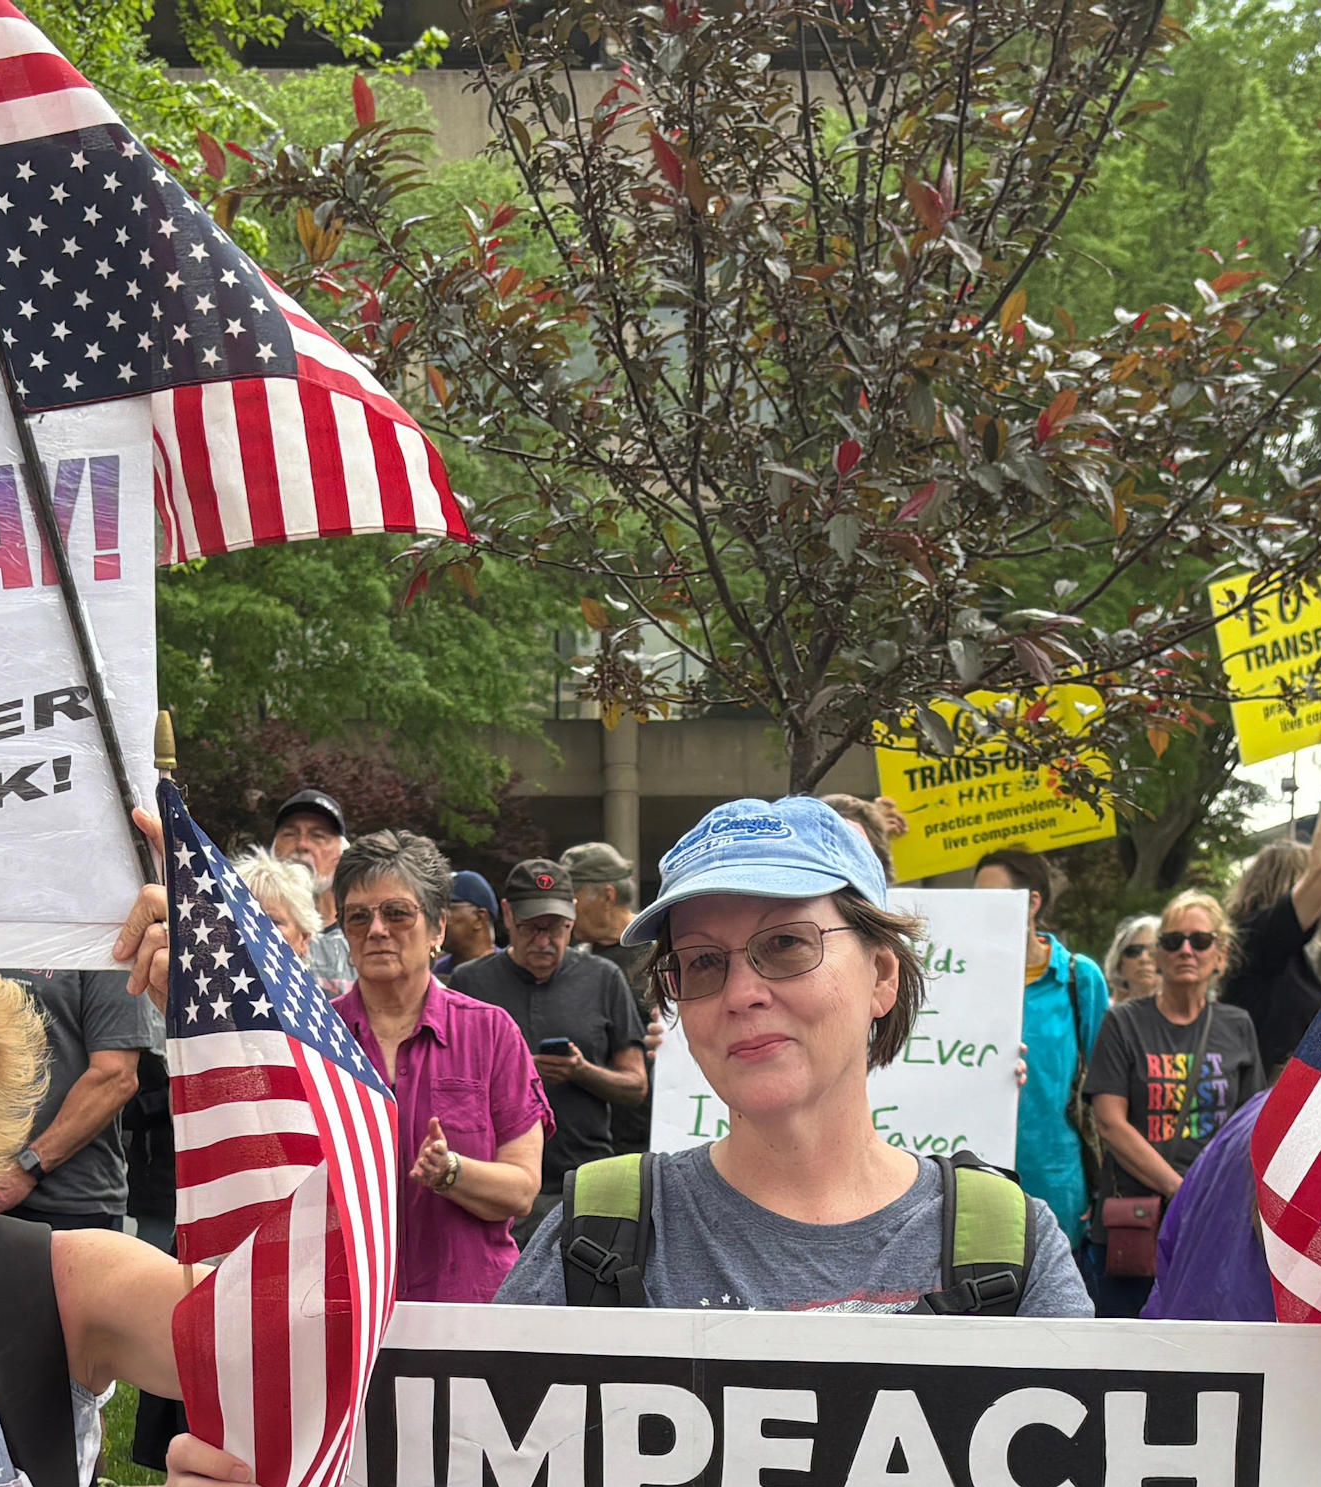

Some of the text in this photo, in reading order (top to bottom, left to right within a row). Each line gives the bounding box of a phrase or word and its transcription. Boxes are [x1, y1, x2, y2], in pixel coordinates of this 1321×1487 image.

[924, 812, 983, 838] practice
[943, 816, 1058, 850] live compassion
[902, 1036, 1000, 1069] Ever
[1147, 1111, 1229, 1142] REIST
